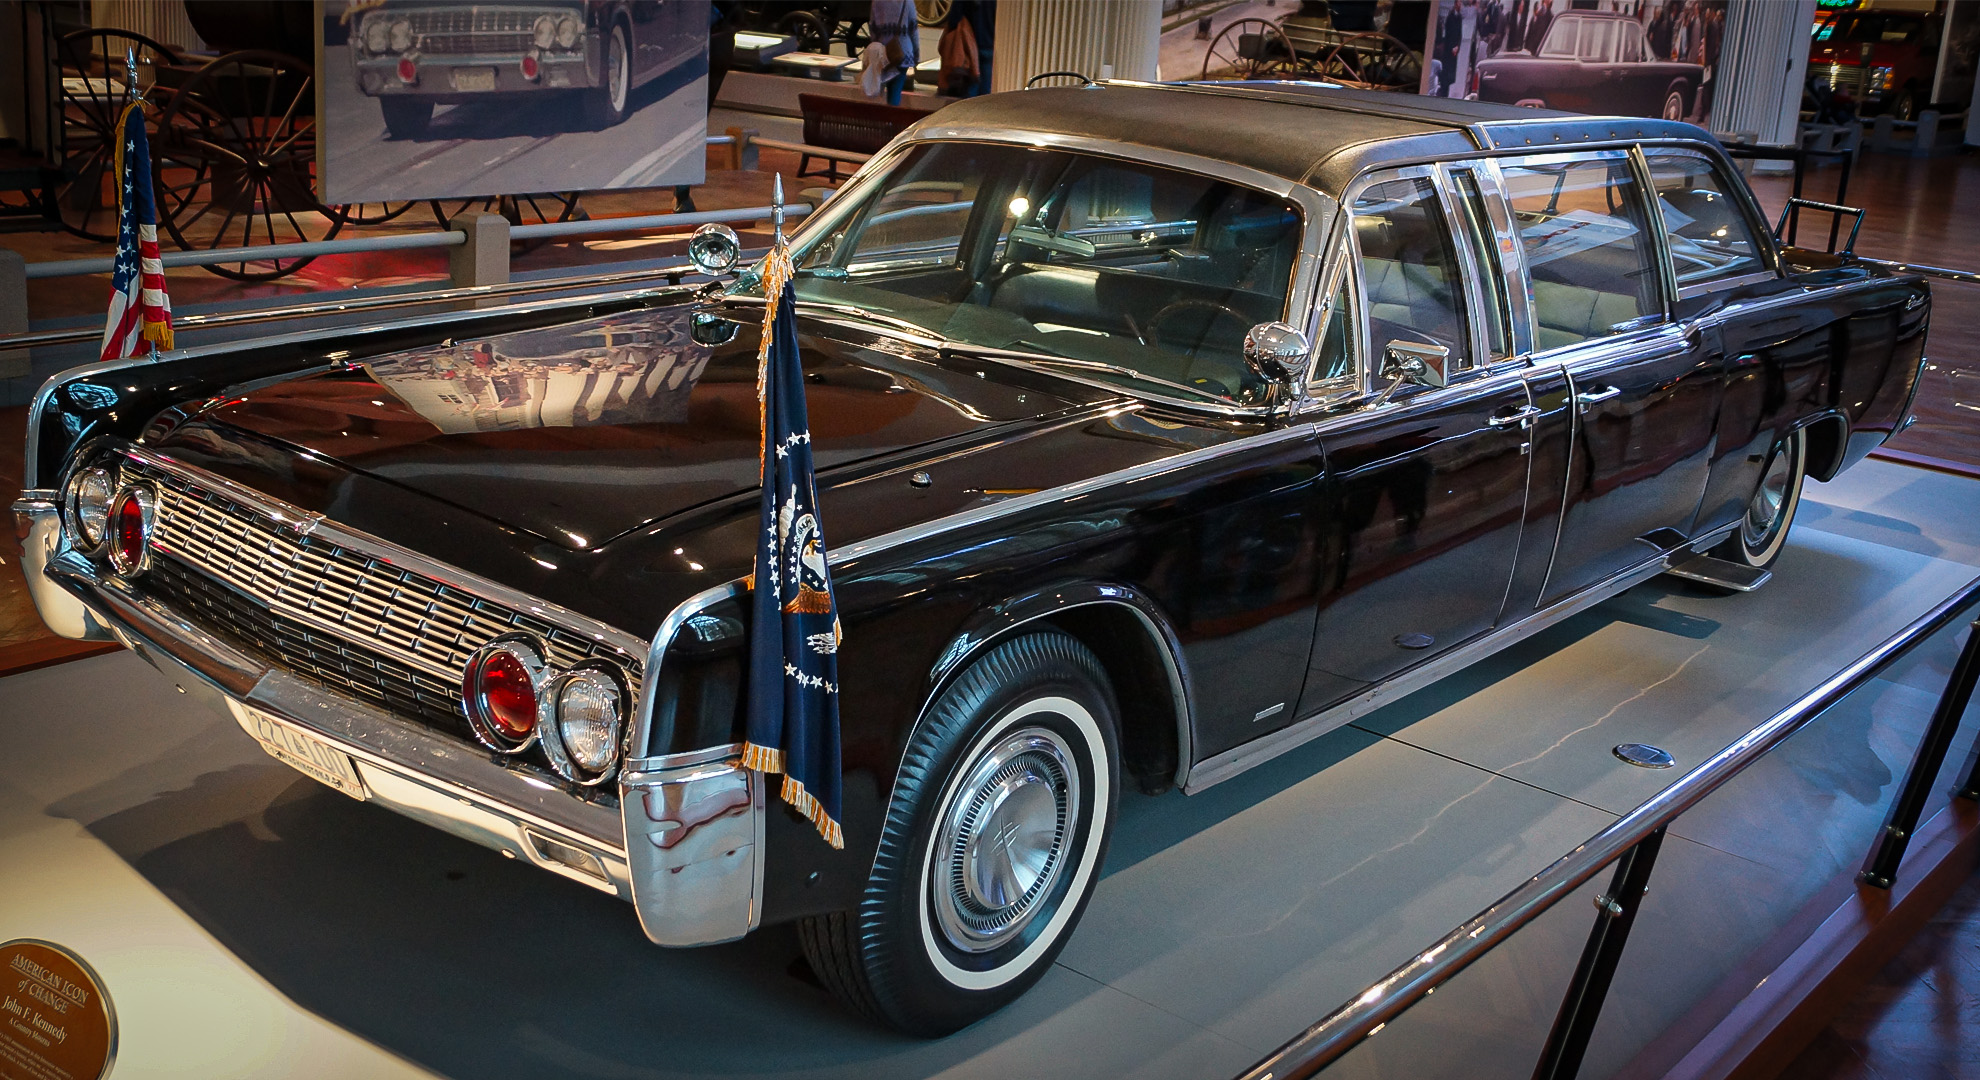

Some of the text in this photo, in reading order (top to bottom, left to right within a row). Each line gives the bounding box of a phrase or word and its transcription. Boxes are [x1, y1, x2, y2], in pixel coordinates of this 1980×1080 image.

[11, 953, 90, 1004] AMERICAN ICON
[18, 978, 69, 1014] of CHANGE
[1, 995, 68, 1045] John F. Kennedy
